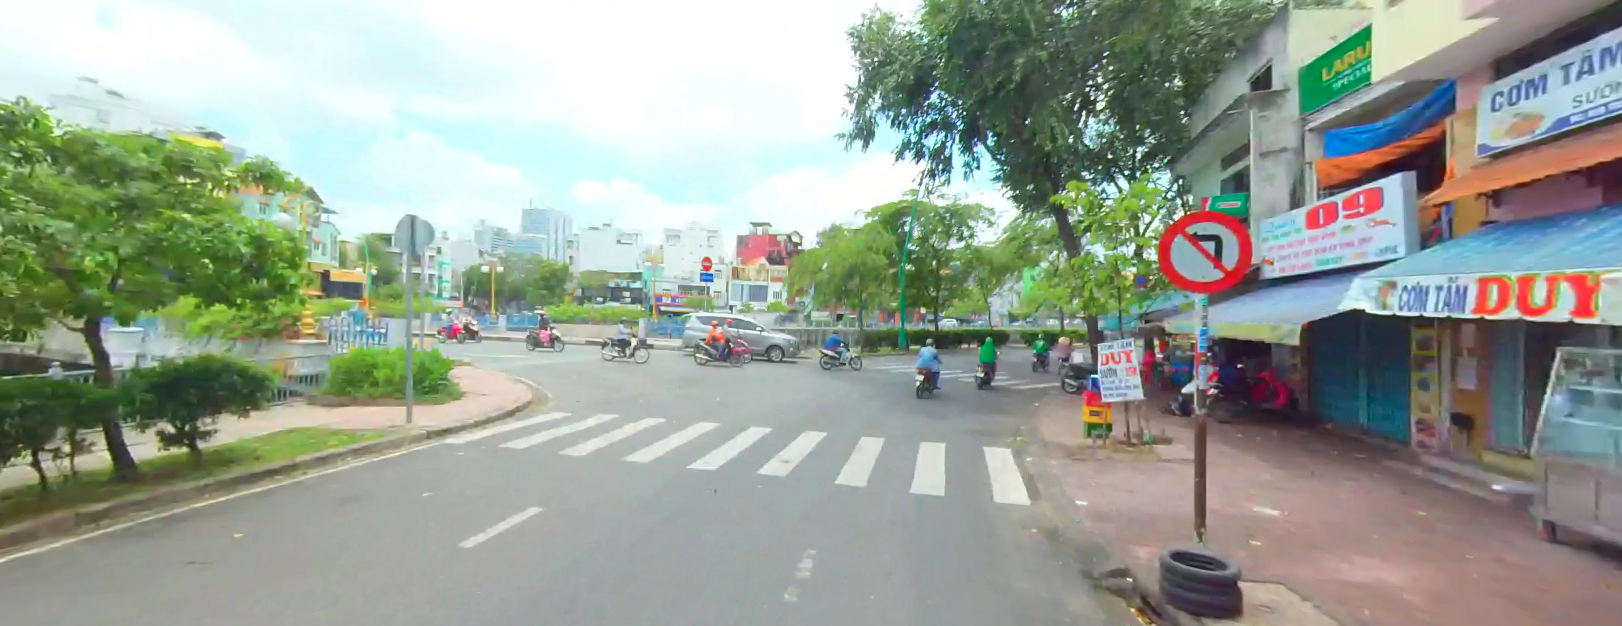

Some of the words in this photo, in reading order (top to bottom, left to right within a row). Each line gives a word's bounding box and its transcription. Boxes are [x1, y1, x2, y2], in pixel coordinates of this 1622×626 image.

[1490, 73, 1548, 113] CƠM
[1305, 186, 1384, 230] 09
[1398, 281, 1430, 313] CƠM
[1471, 273, 1602, 318] DUY
[1101, 350, 1133, 365] DUY
